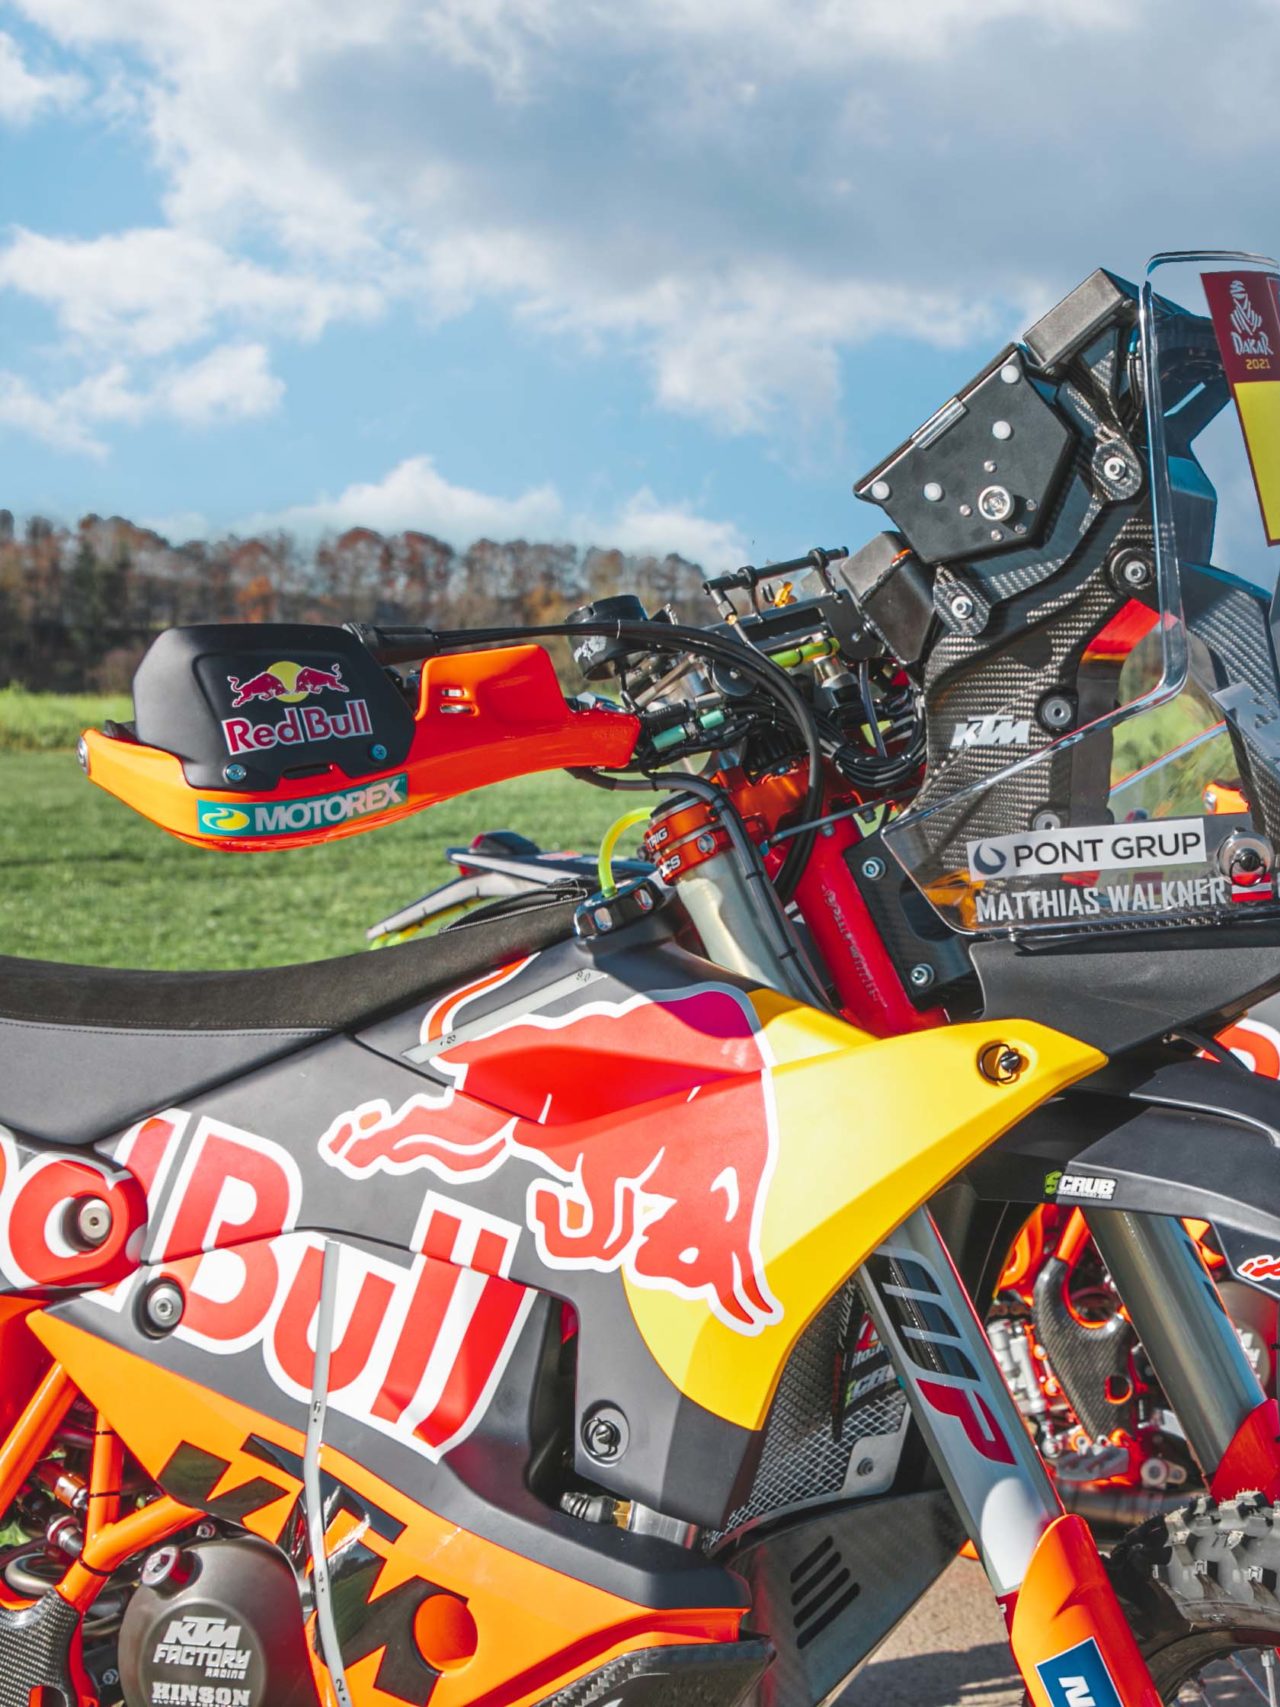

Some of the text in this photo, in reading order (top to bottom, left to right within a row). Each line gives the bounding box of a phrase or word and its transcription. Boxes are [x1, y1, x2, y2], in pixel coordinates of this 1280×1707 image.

[1230, 331, 1275, 356] DAKAR
[1245, 358, 1271, 370] 2021
[221, 699, 373, 755] Red Bull
[951, 714, 1030, 749] KTM
[254, 775, 405, 833] MOTOREX
[1014, 831, 1201, 867] PONT GRUP
[975, 886, 1100, 923] MATTHIAS
[1107, 876, 1227, 913] WALKNER
[145, 1114, 538, 1464] Bull
[162, 1615, 242, 1649] KTM
[152, 1643, 253, 1670] FACTORY
[204, 1667, 247, 1680] RACING
[151, 1681, 252, 1706] HINSON
